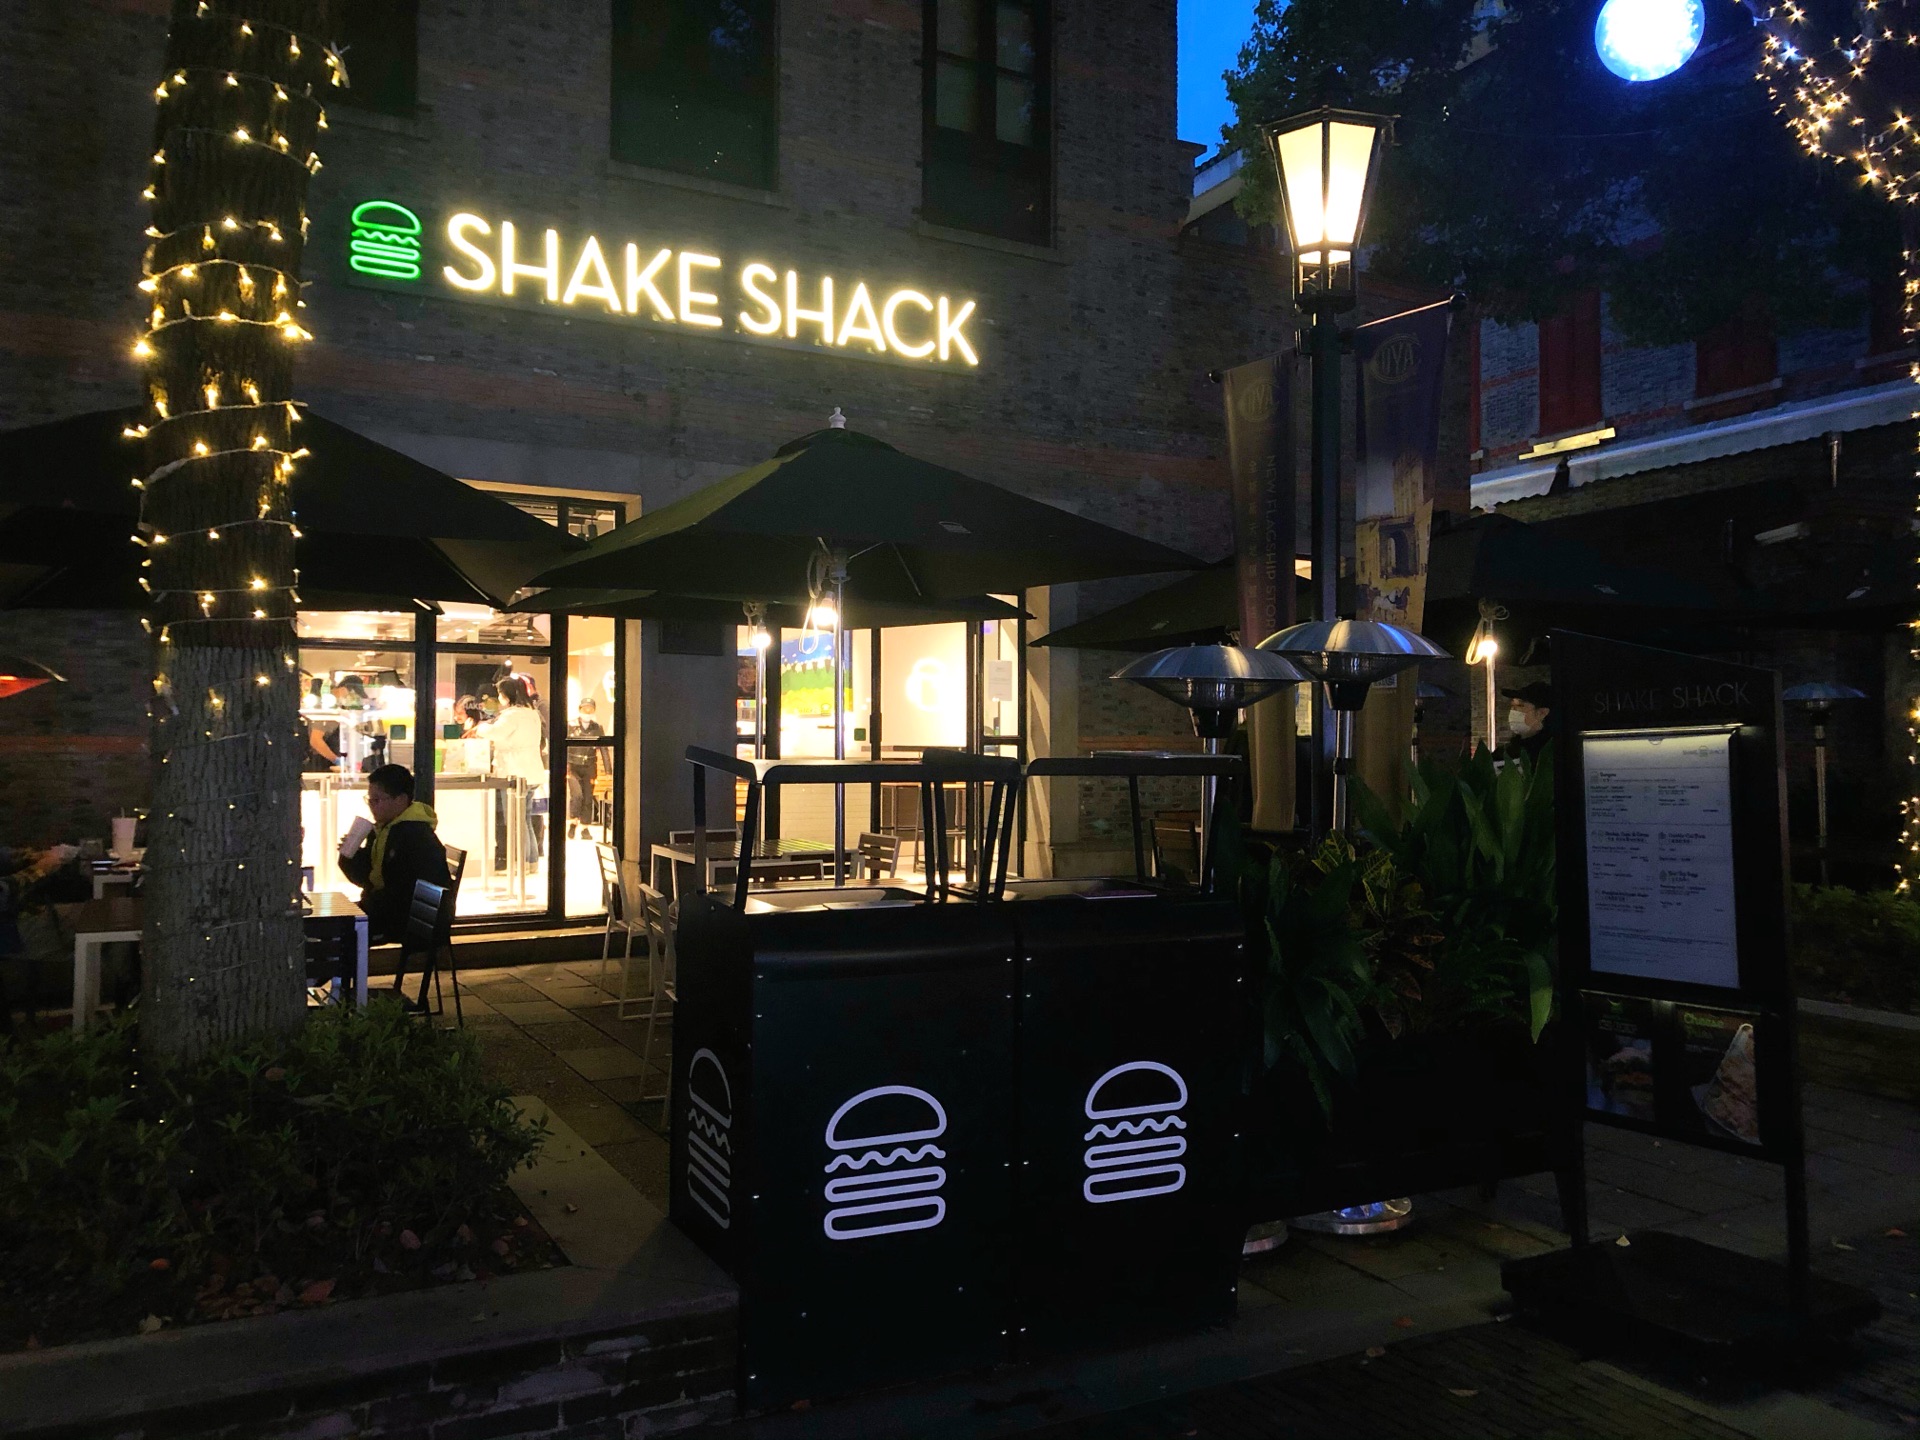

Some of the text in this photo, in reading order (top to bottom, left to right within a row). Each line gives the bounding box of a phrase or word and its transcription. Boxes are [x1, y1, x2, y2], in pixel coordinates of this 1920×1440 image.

[442, 212, 979, 367] SHAKE SHACK
[1265, 454, 1277, 494] NEW
[1265, 498, 1277, 580] FLAGSHIP
[1593, 680, 1751, 714] SHAKE SHACK
